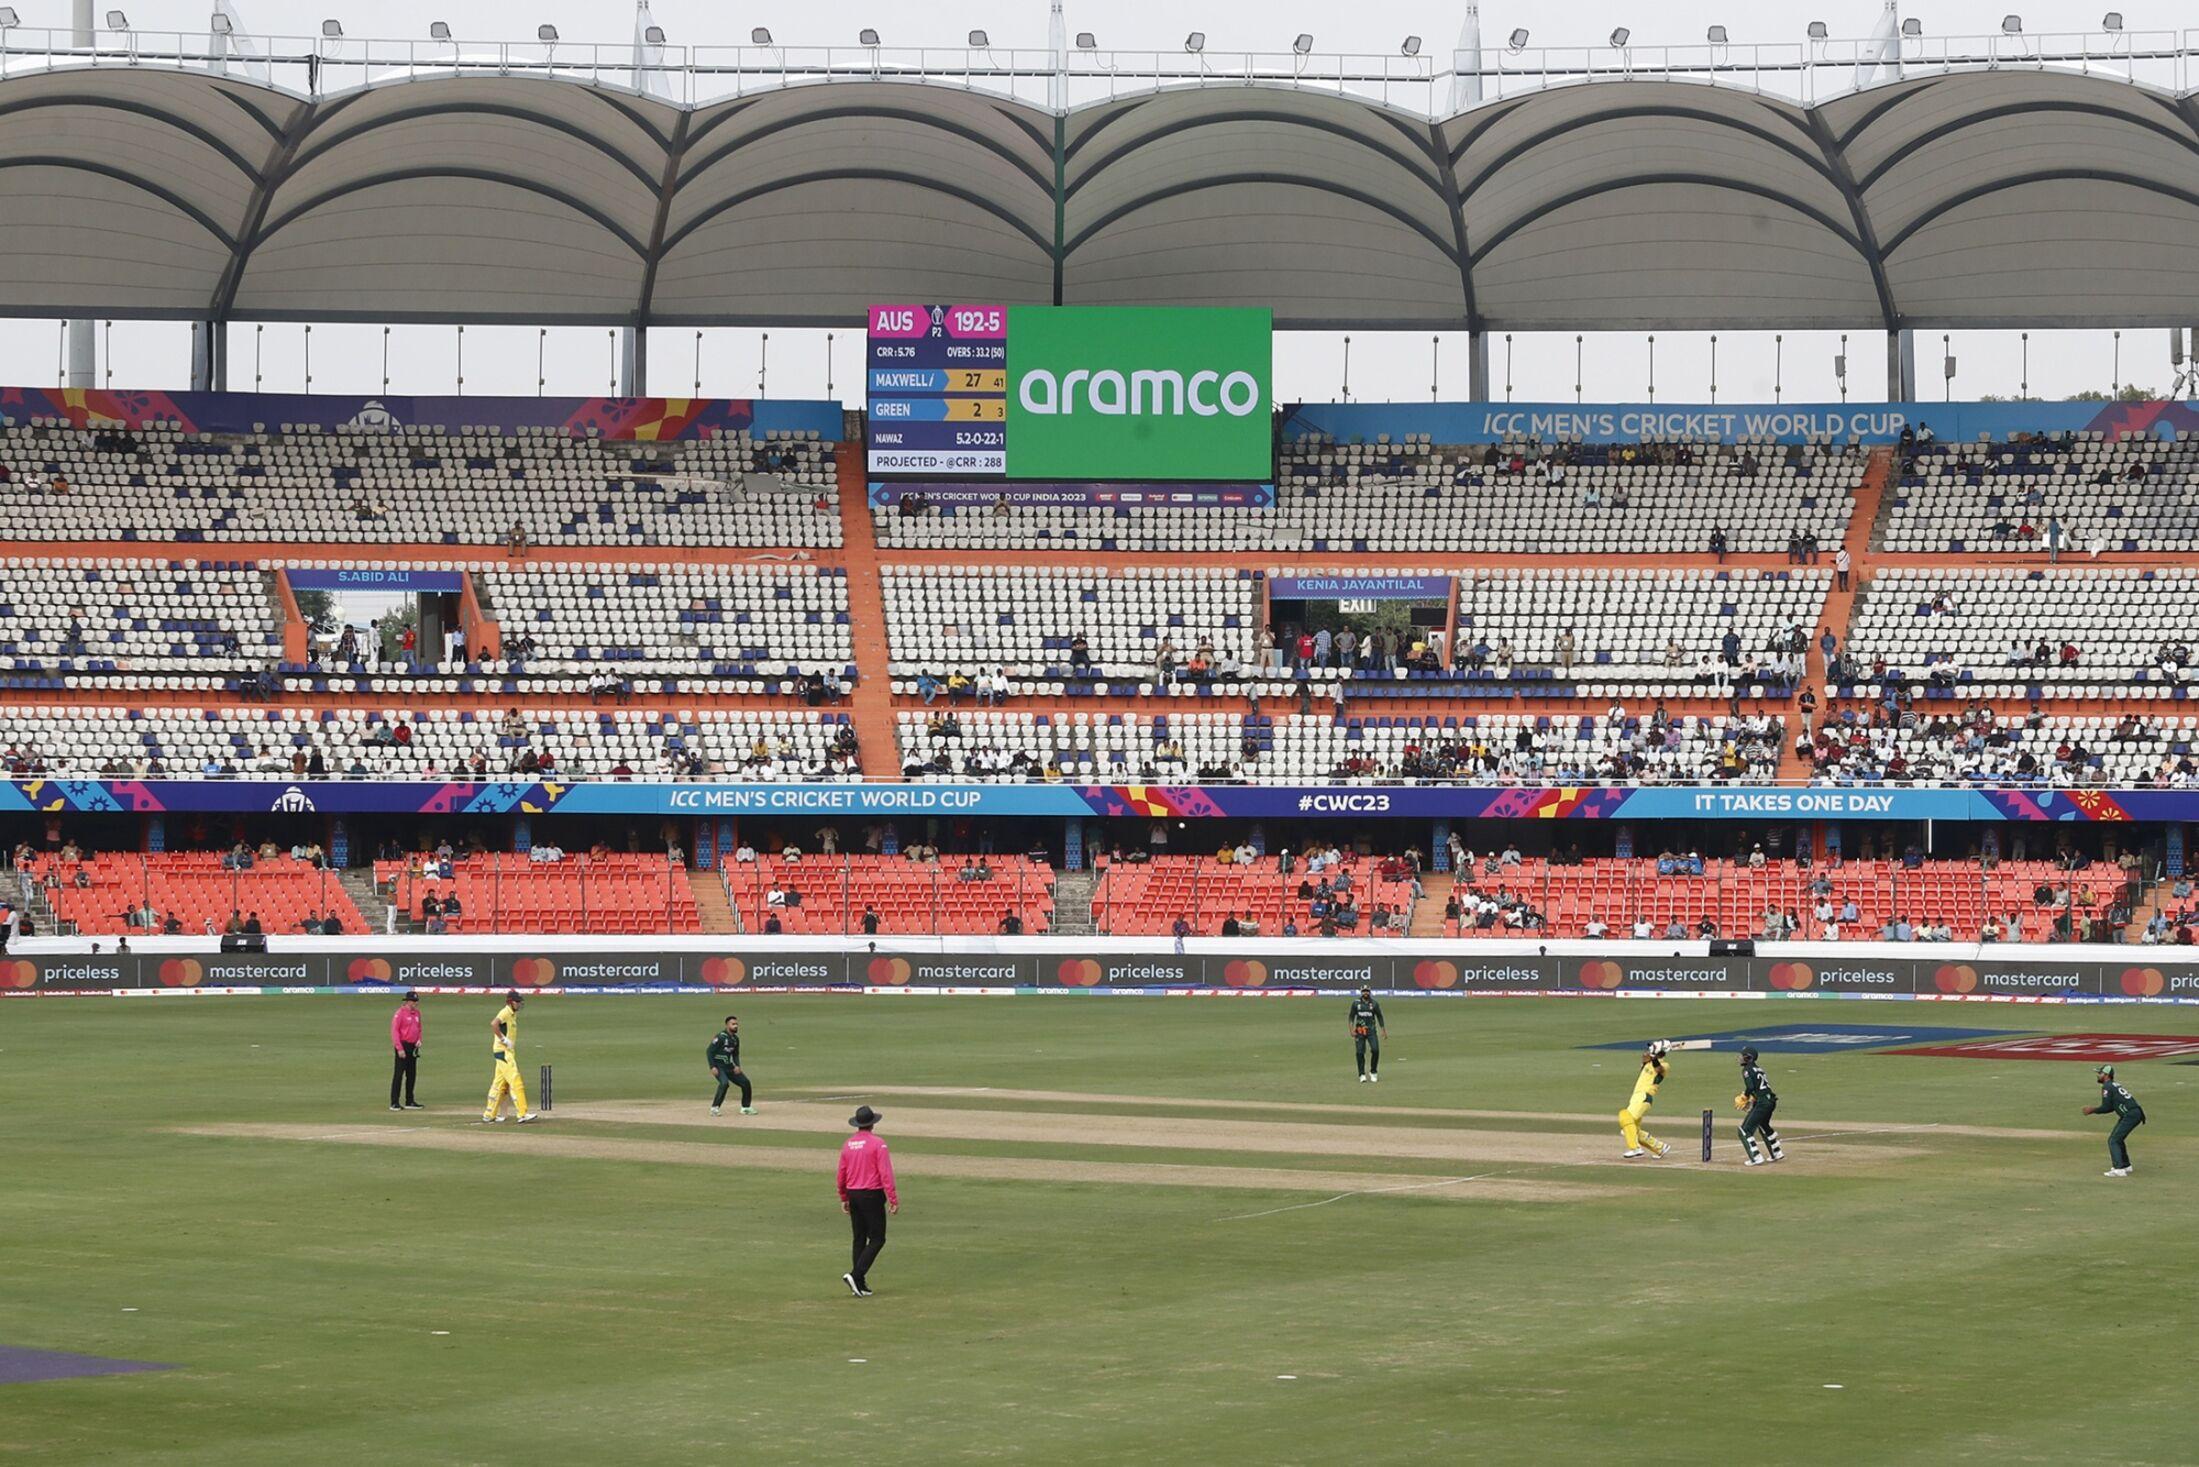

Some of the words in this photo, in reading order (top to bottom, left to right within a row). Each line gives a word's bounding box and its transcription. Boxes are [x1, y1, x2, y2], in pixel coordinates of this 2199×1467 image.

[876, 310, 914, 332] AUS
[954, 311, 1000, 332] 192-5
[931, 327, 942, 338] P2
[991, 346, 1005, 360] (50)
[965, 373, 982, 388] 27
[993, 377, 1004, 388] 41
[1018, 368, 1260, 417] aramco
[875, 403, 911, 417] GREEN
[972, 402, 982, 418] 2
[997, 407, 1004, 418] 3
[1483, 413, 1525, 436] ICC
[1532, 413, 1615, 436] MEN'S
[1620, 413, 1737, 436] CRICKET
[1744, 413, 1844, 436] WORLD
[1850, 413, 1906, 436] CUP
[875, 433, 904, 444] NAWAZ
[876, 456, 938, 467] PROJECTED
[946, 456, 977, 469] @CRR
[984, 457, 1002, 467] 288
[942, 492, 978, 501] CRICKET
[979, 492, 1012, 501] WORD
[1013, 492, 1031, 502] CUP
[1032, 492, 1060, 502] INDIA
[1061, 493, 1087, 502] 2023
[338, 571, 385, 582] S.ABID
[387, 572, 409, 582] ALI
[1296, 579, 1339, 590] KENIA
[1342, 579, 1425, 590] JAYANTILAL
[670, 791, 701, 807] ICC
[705, 791, 767, 807] MEN'S
[771, 791, 855, 807] CRICKET
[861, 791, 936, 807] WORLD
[940, 792, 981, 808] CUP
[1298, 795, 1390, 812] #CWC23
[1695, 794, 1715, 811] IT
[1720, 794, 1792, 812] TAKES
[1797, 795, 1843, 812] ONE
[1849, 796, 1894, 812] DAY
[44, 964, 119, 982] priceless
[210, 963, 307, 979] mastercard
[399, 963, 473, 981] priceless
[562, 962, 660, 977] mastercard
[752, 962, 828, 980] priceless
[918, 963, 1016, 979] mastercard
[1109, 963, 1184, 981] priceless
[1274, 965, 1371, 981] mastercard
[1464, 965, 1539, 983] priceless
[1629, 966, 1727, 982] mastercard
[1819, 968, 1895, 986] priceless
[1983, 972, 2080, 987] mastercard
